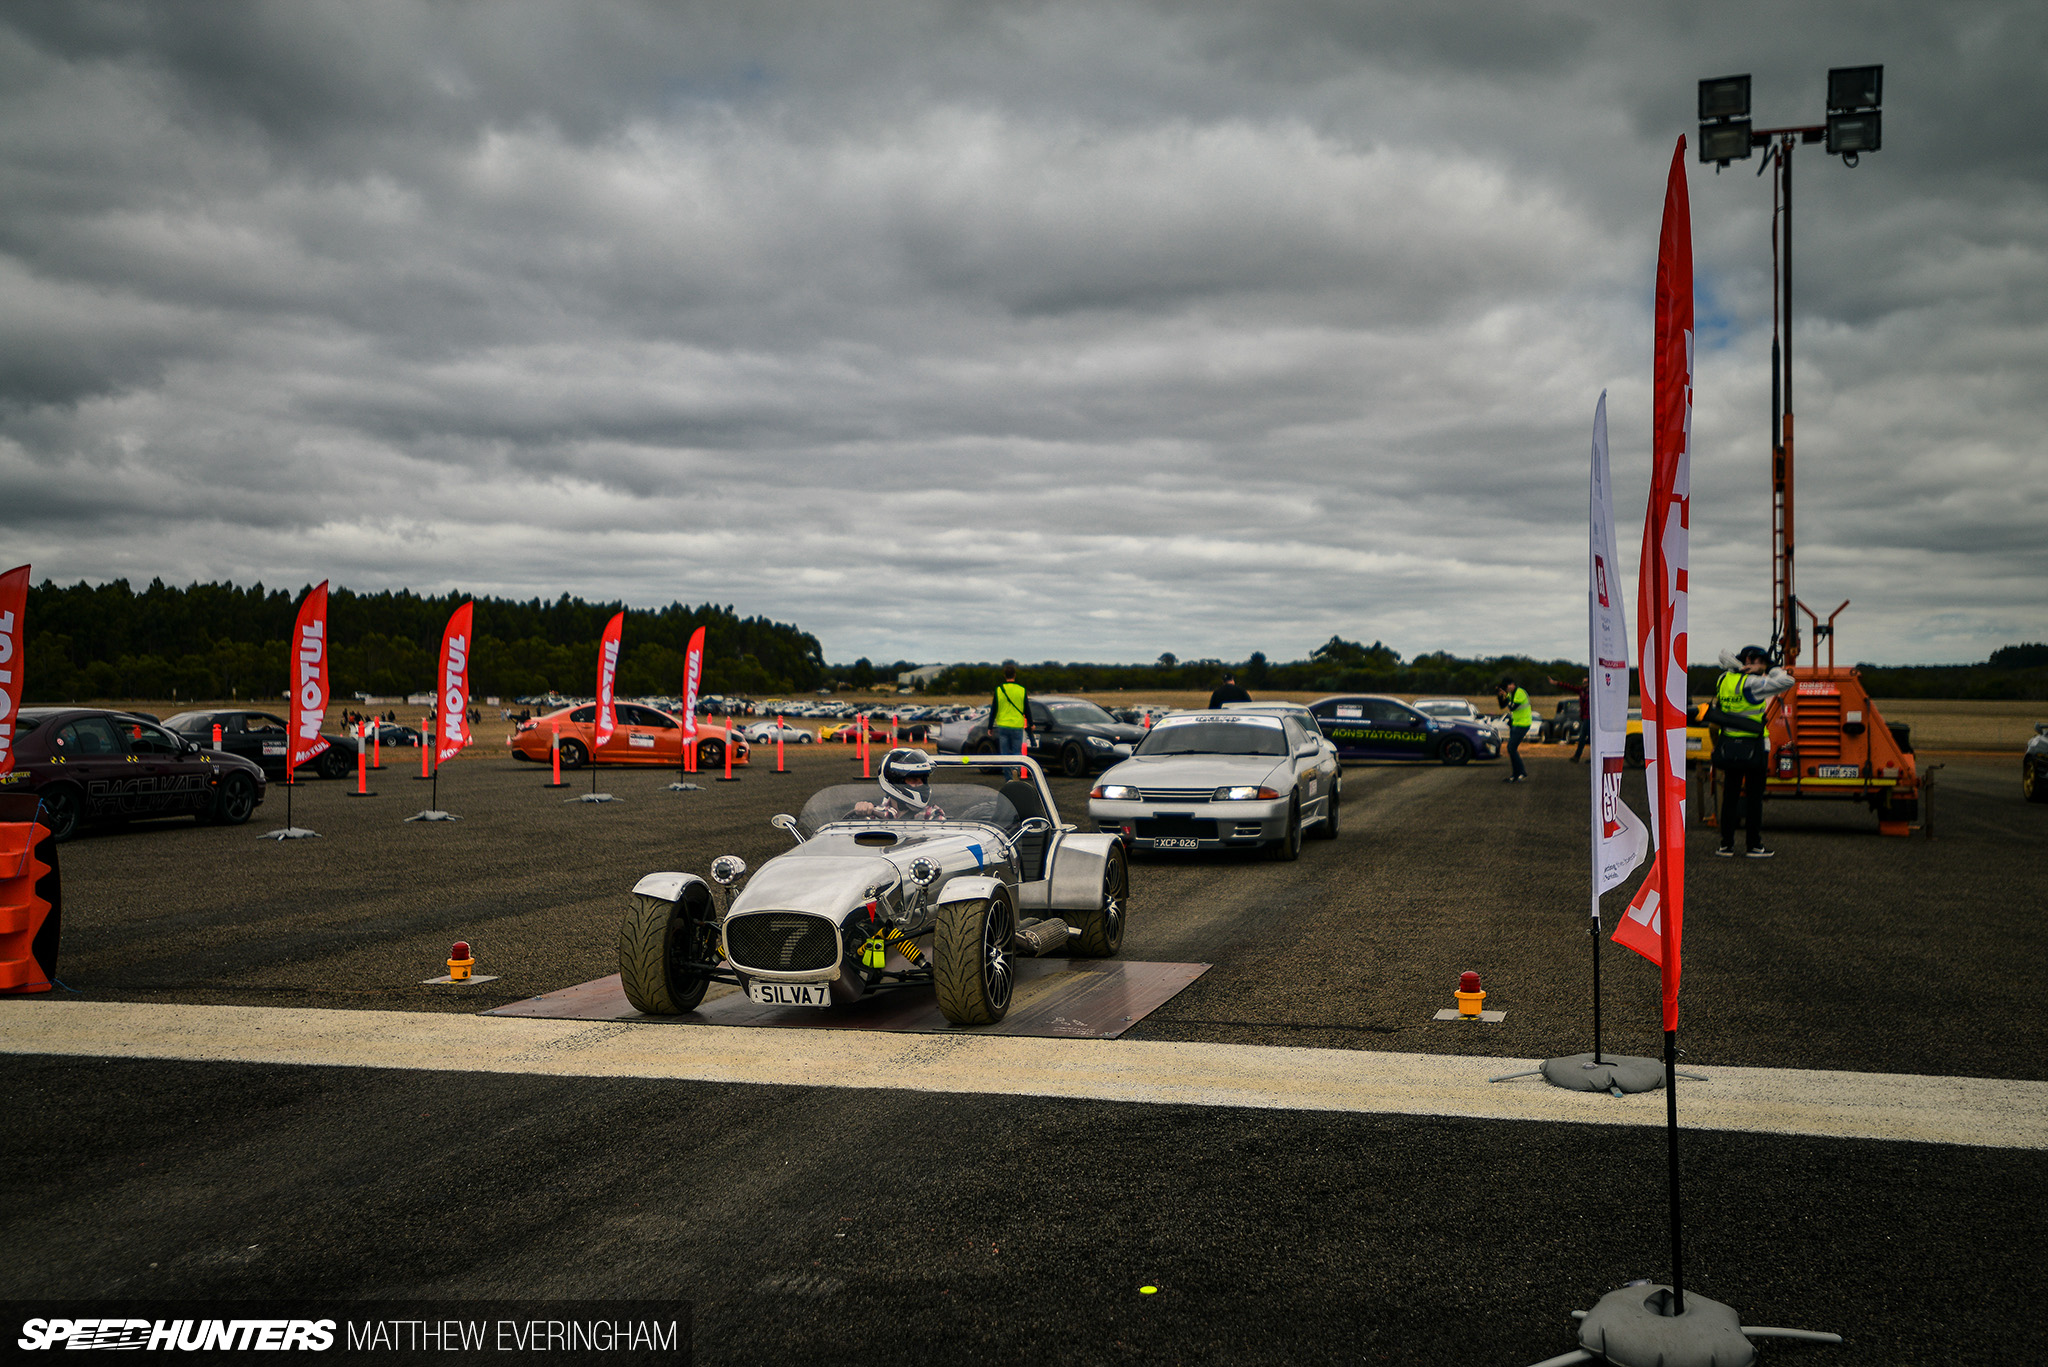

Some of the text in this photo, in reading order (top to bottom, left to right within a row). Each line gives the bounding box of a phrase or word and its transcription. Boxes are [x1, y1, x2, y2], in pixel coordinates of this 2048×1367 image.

[300, 619, 323, 740] MOTUL
[445, 634, 466, 742] MOTUL
[600, 638, 619, 731] MOTUL
[685, 649, 700, 733] MOTUL
[761, 985, 826, 1004] SILVA 7
